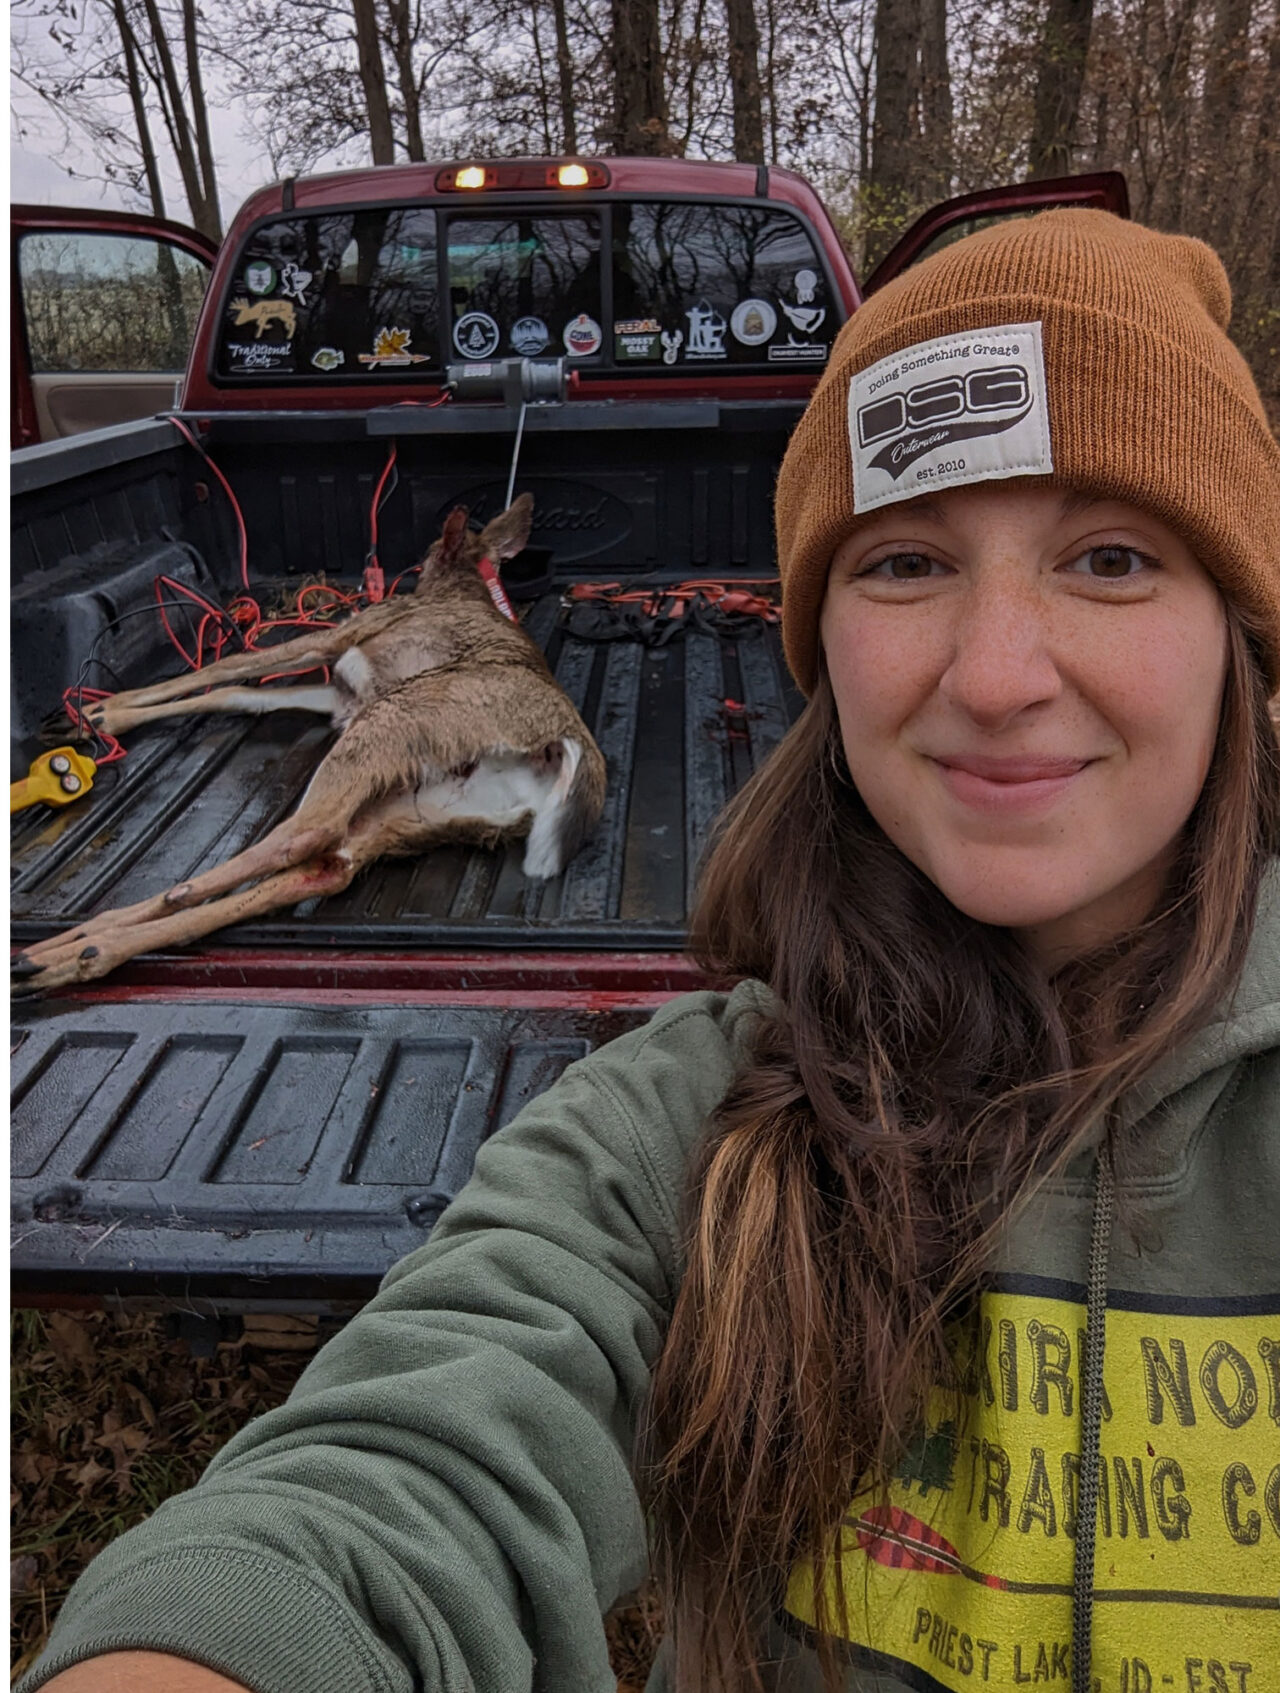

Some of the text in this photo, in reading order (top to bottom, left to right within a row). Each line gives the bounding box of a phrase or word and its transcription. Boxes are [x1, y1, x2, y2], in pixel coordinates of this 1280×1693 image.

[615, 319, 662, 334] FERAL
[570, 329, 595, 341] GONE
[620, 336, 656, 346] MOSSY
[228, 342, 292, 358] Traditional
[626, 345, 649, 354] OAK
[244, 354, 272, 368] Only
[868, 368, 900, 395] Doing
[901, 346, 971, 375] Something
[857, 364, 1031, 449] DSG
[891, 430, 950, 464] Outerwear
[913, 1607, 998, 1682] PRIEST
